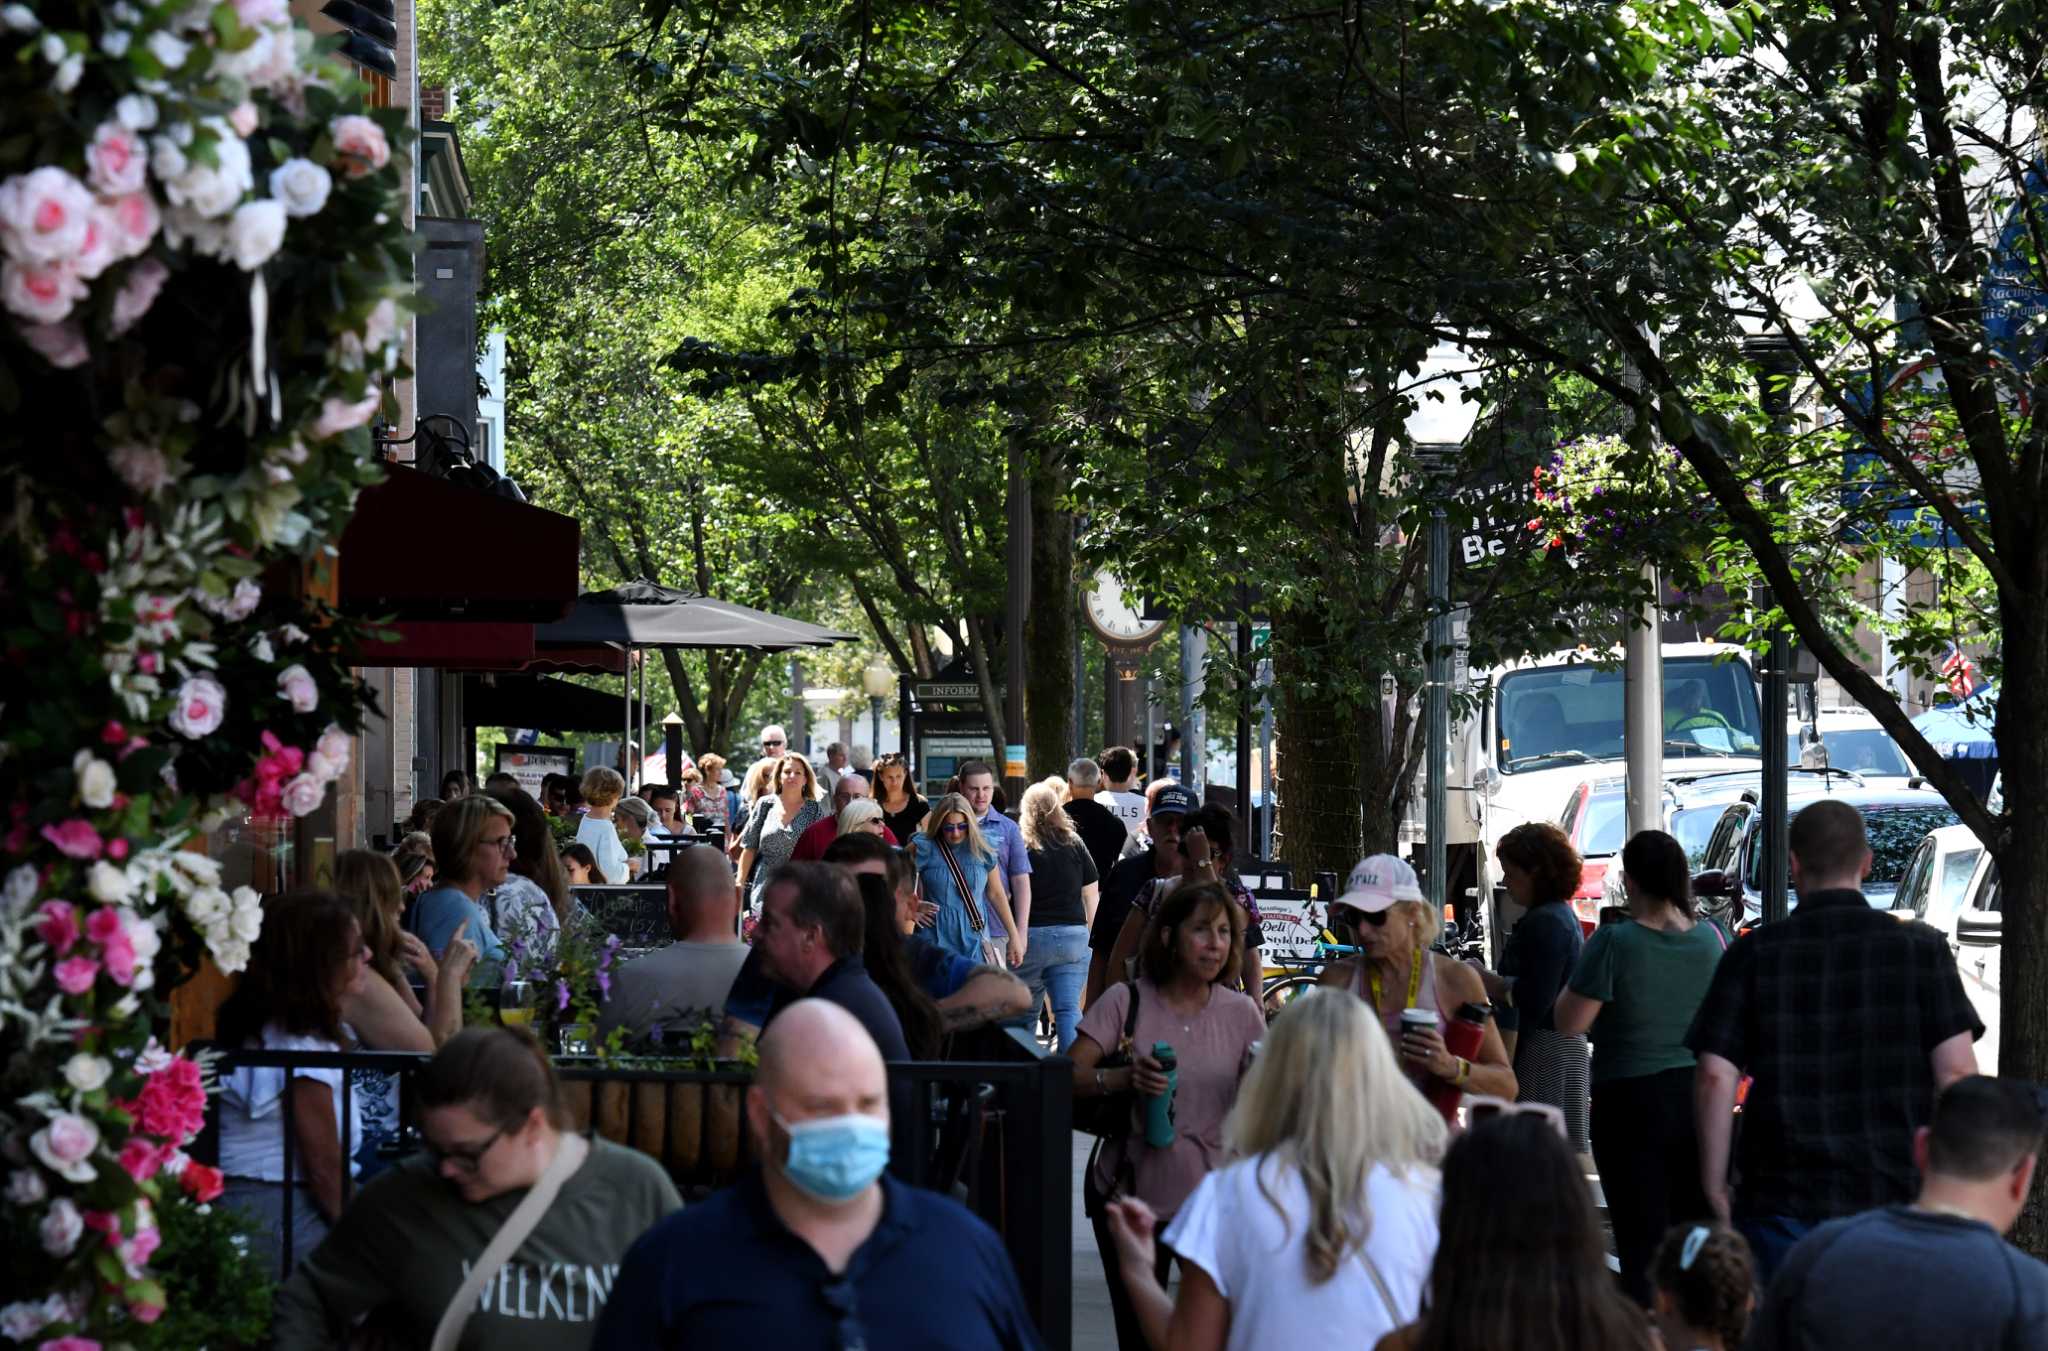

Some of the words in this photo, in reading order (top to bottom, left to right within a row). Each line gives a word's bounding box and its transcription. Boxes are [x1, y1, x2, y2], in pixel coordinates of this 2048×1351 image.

[1106, 804, 1138, 818] LLS
[1262, 921, 1286, 932] Deli
[462, 1259, 619, 1322] WEEKEN
